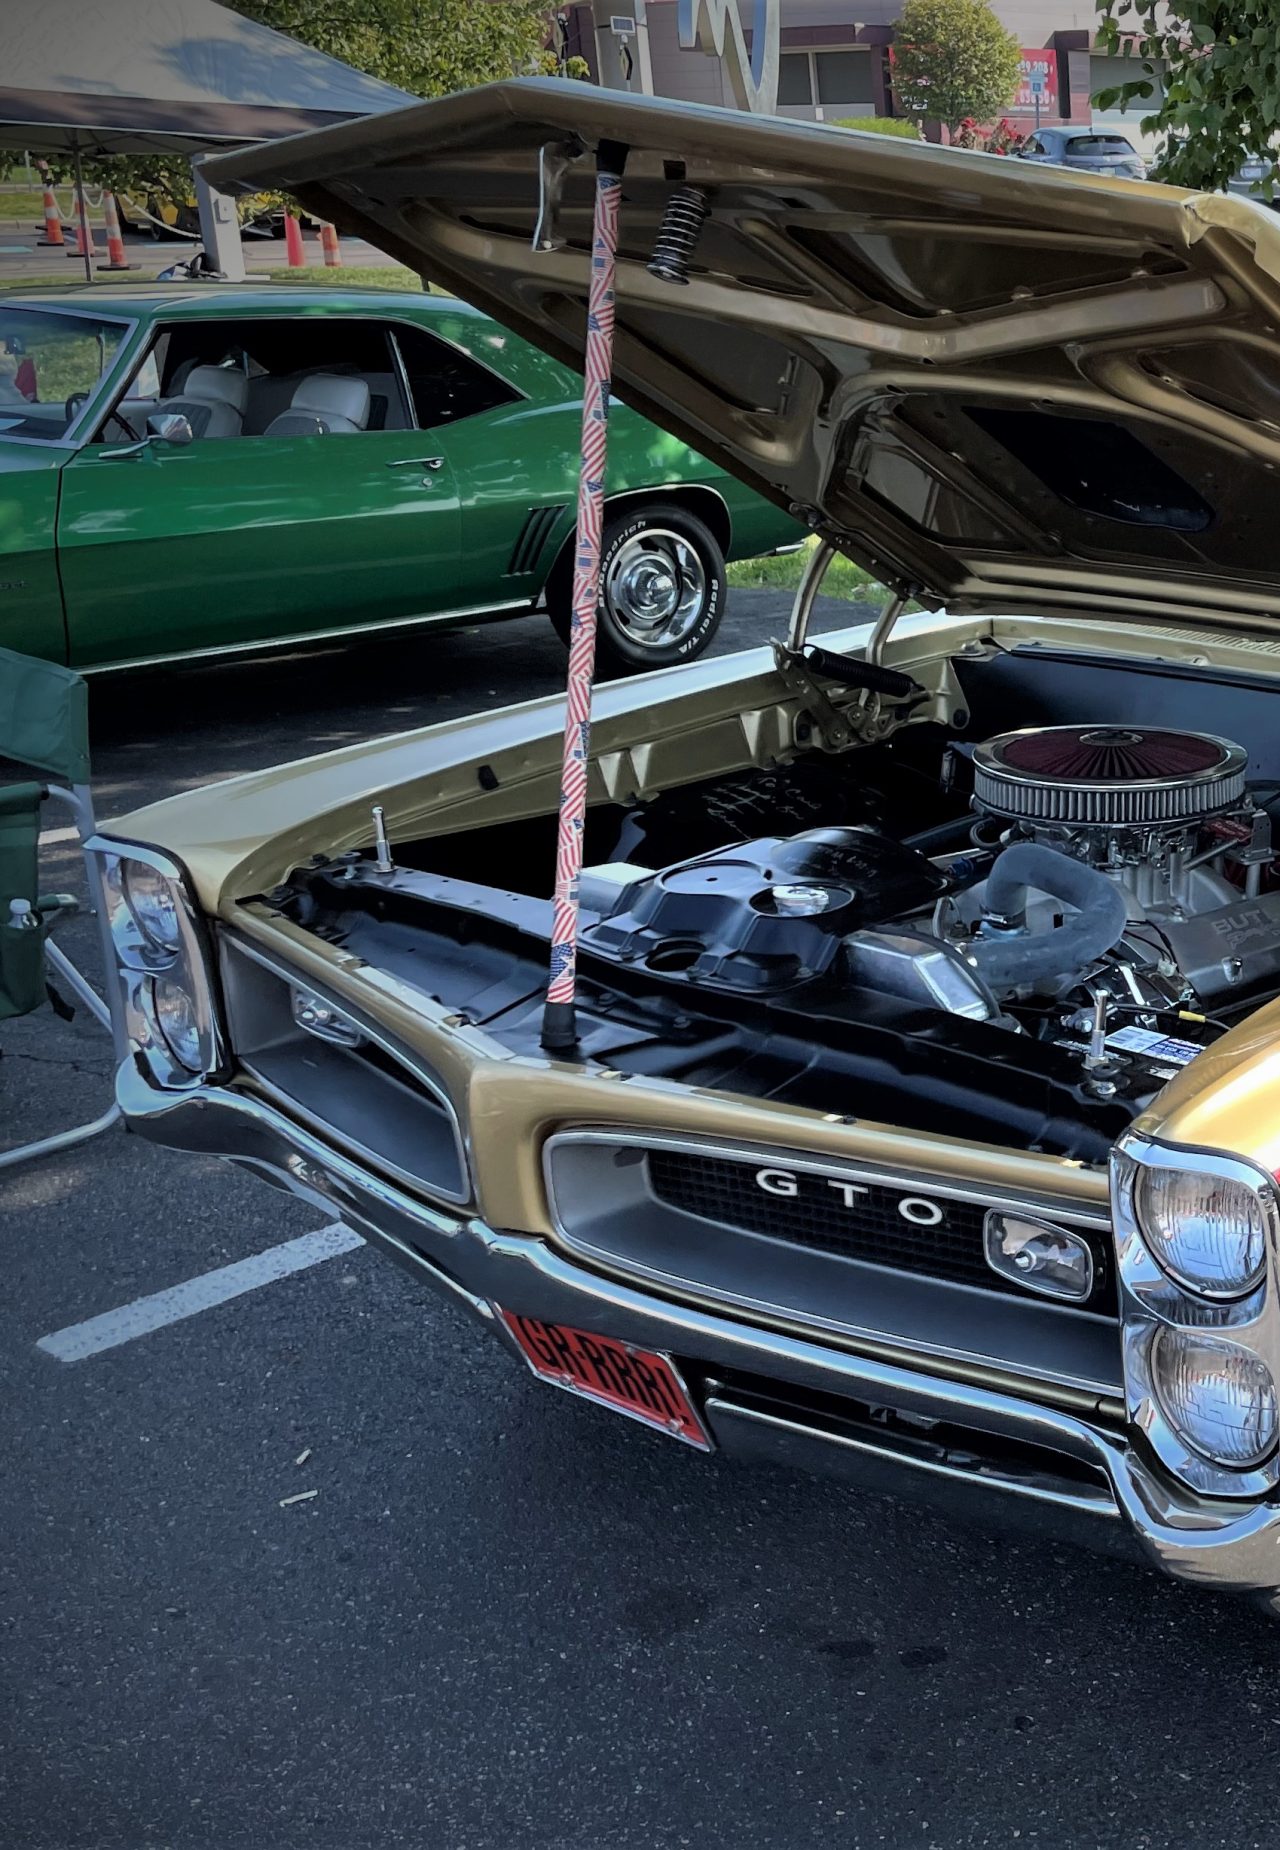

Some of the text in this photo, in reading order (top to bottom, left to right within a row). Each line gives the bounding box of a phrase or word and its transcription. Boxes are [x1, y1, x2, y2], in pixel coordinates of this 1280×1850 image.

[679, 579, 718, 654] Radial T/A
[756, 1168, 943, 1226] GTO
